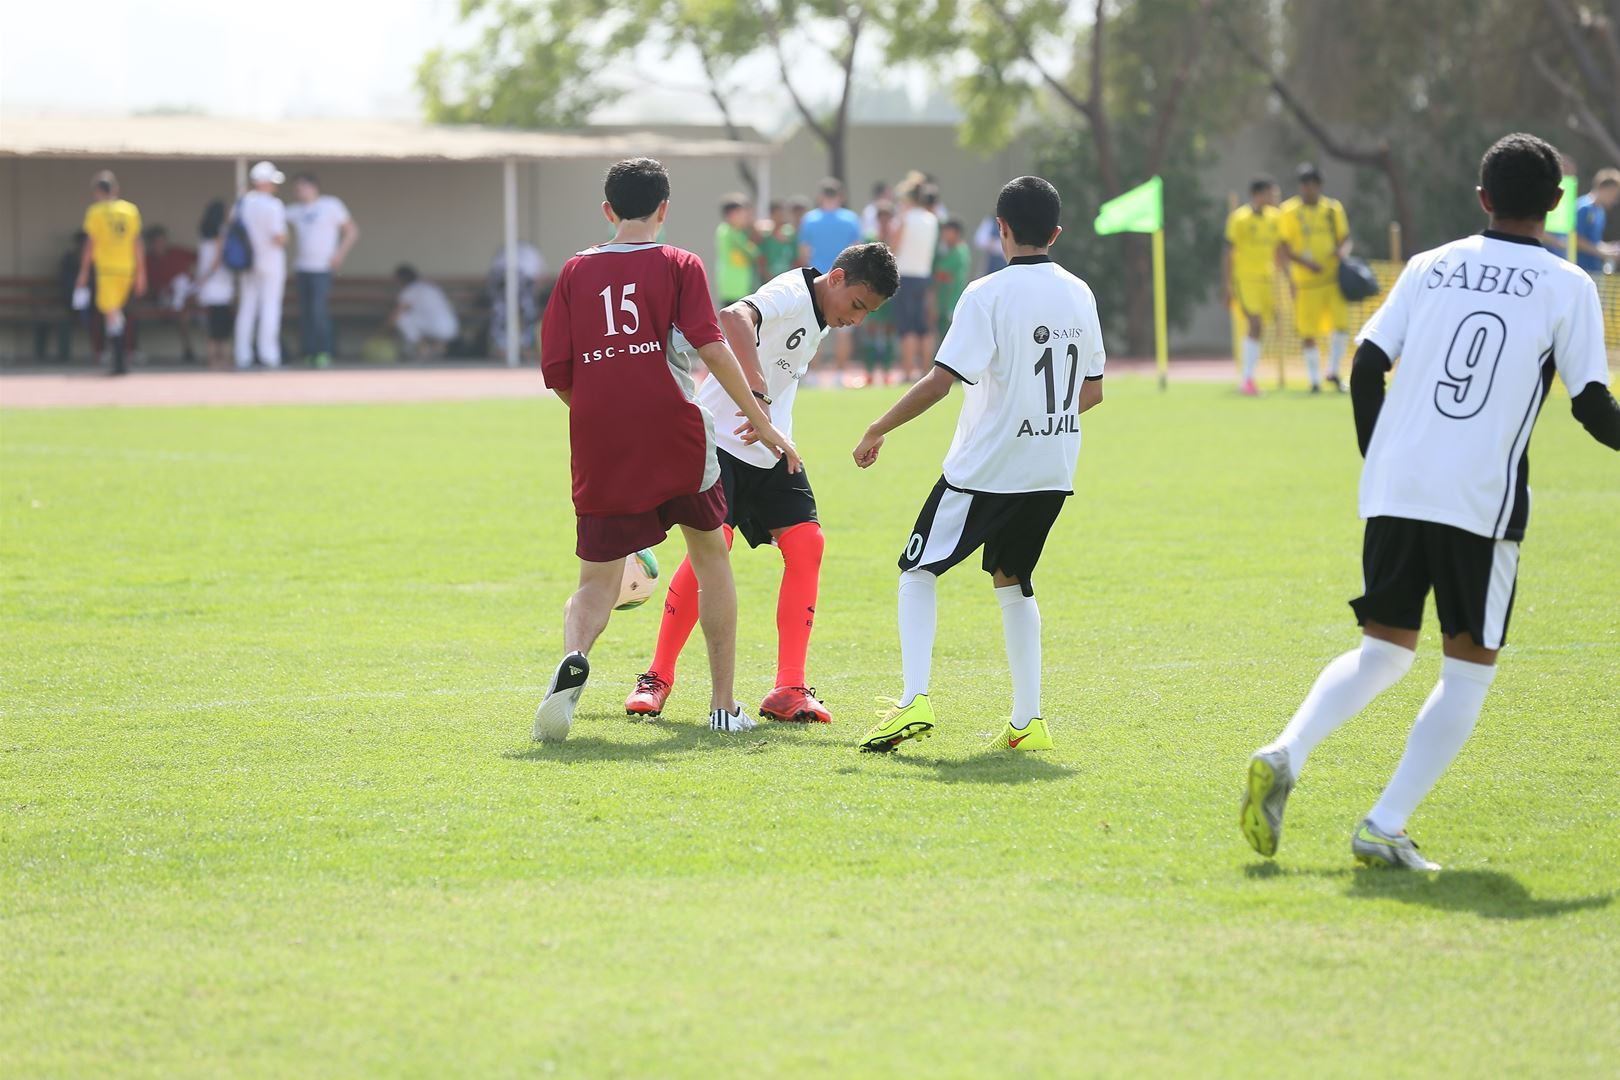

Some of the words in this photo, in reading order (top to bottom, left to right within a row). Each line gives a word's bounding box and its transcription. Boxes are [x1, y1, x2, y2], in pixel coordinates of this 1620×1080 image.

[1427, 260, 1539, 298] SABIS
[599, 283, 639, 337] 15
[582, 347, 616, 364] ISC
[628, 341, 662, 355] DOH
[785, 327, 806, 350] 6
[1434, 311, 1507, 420] 9
